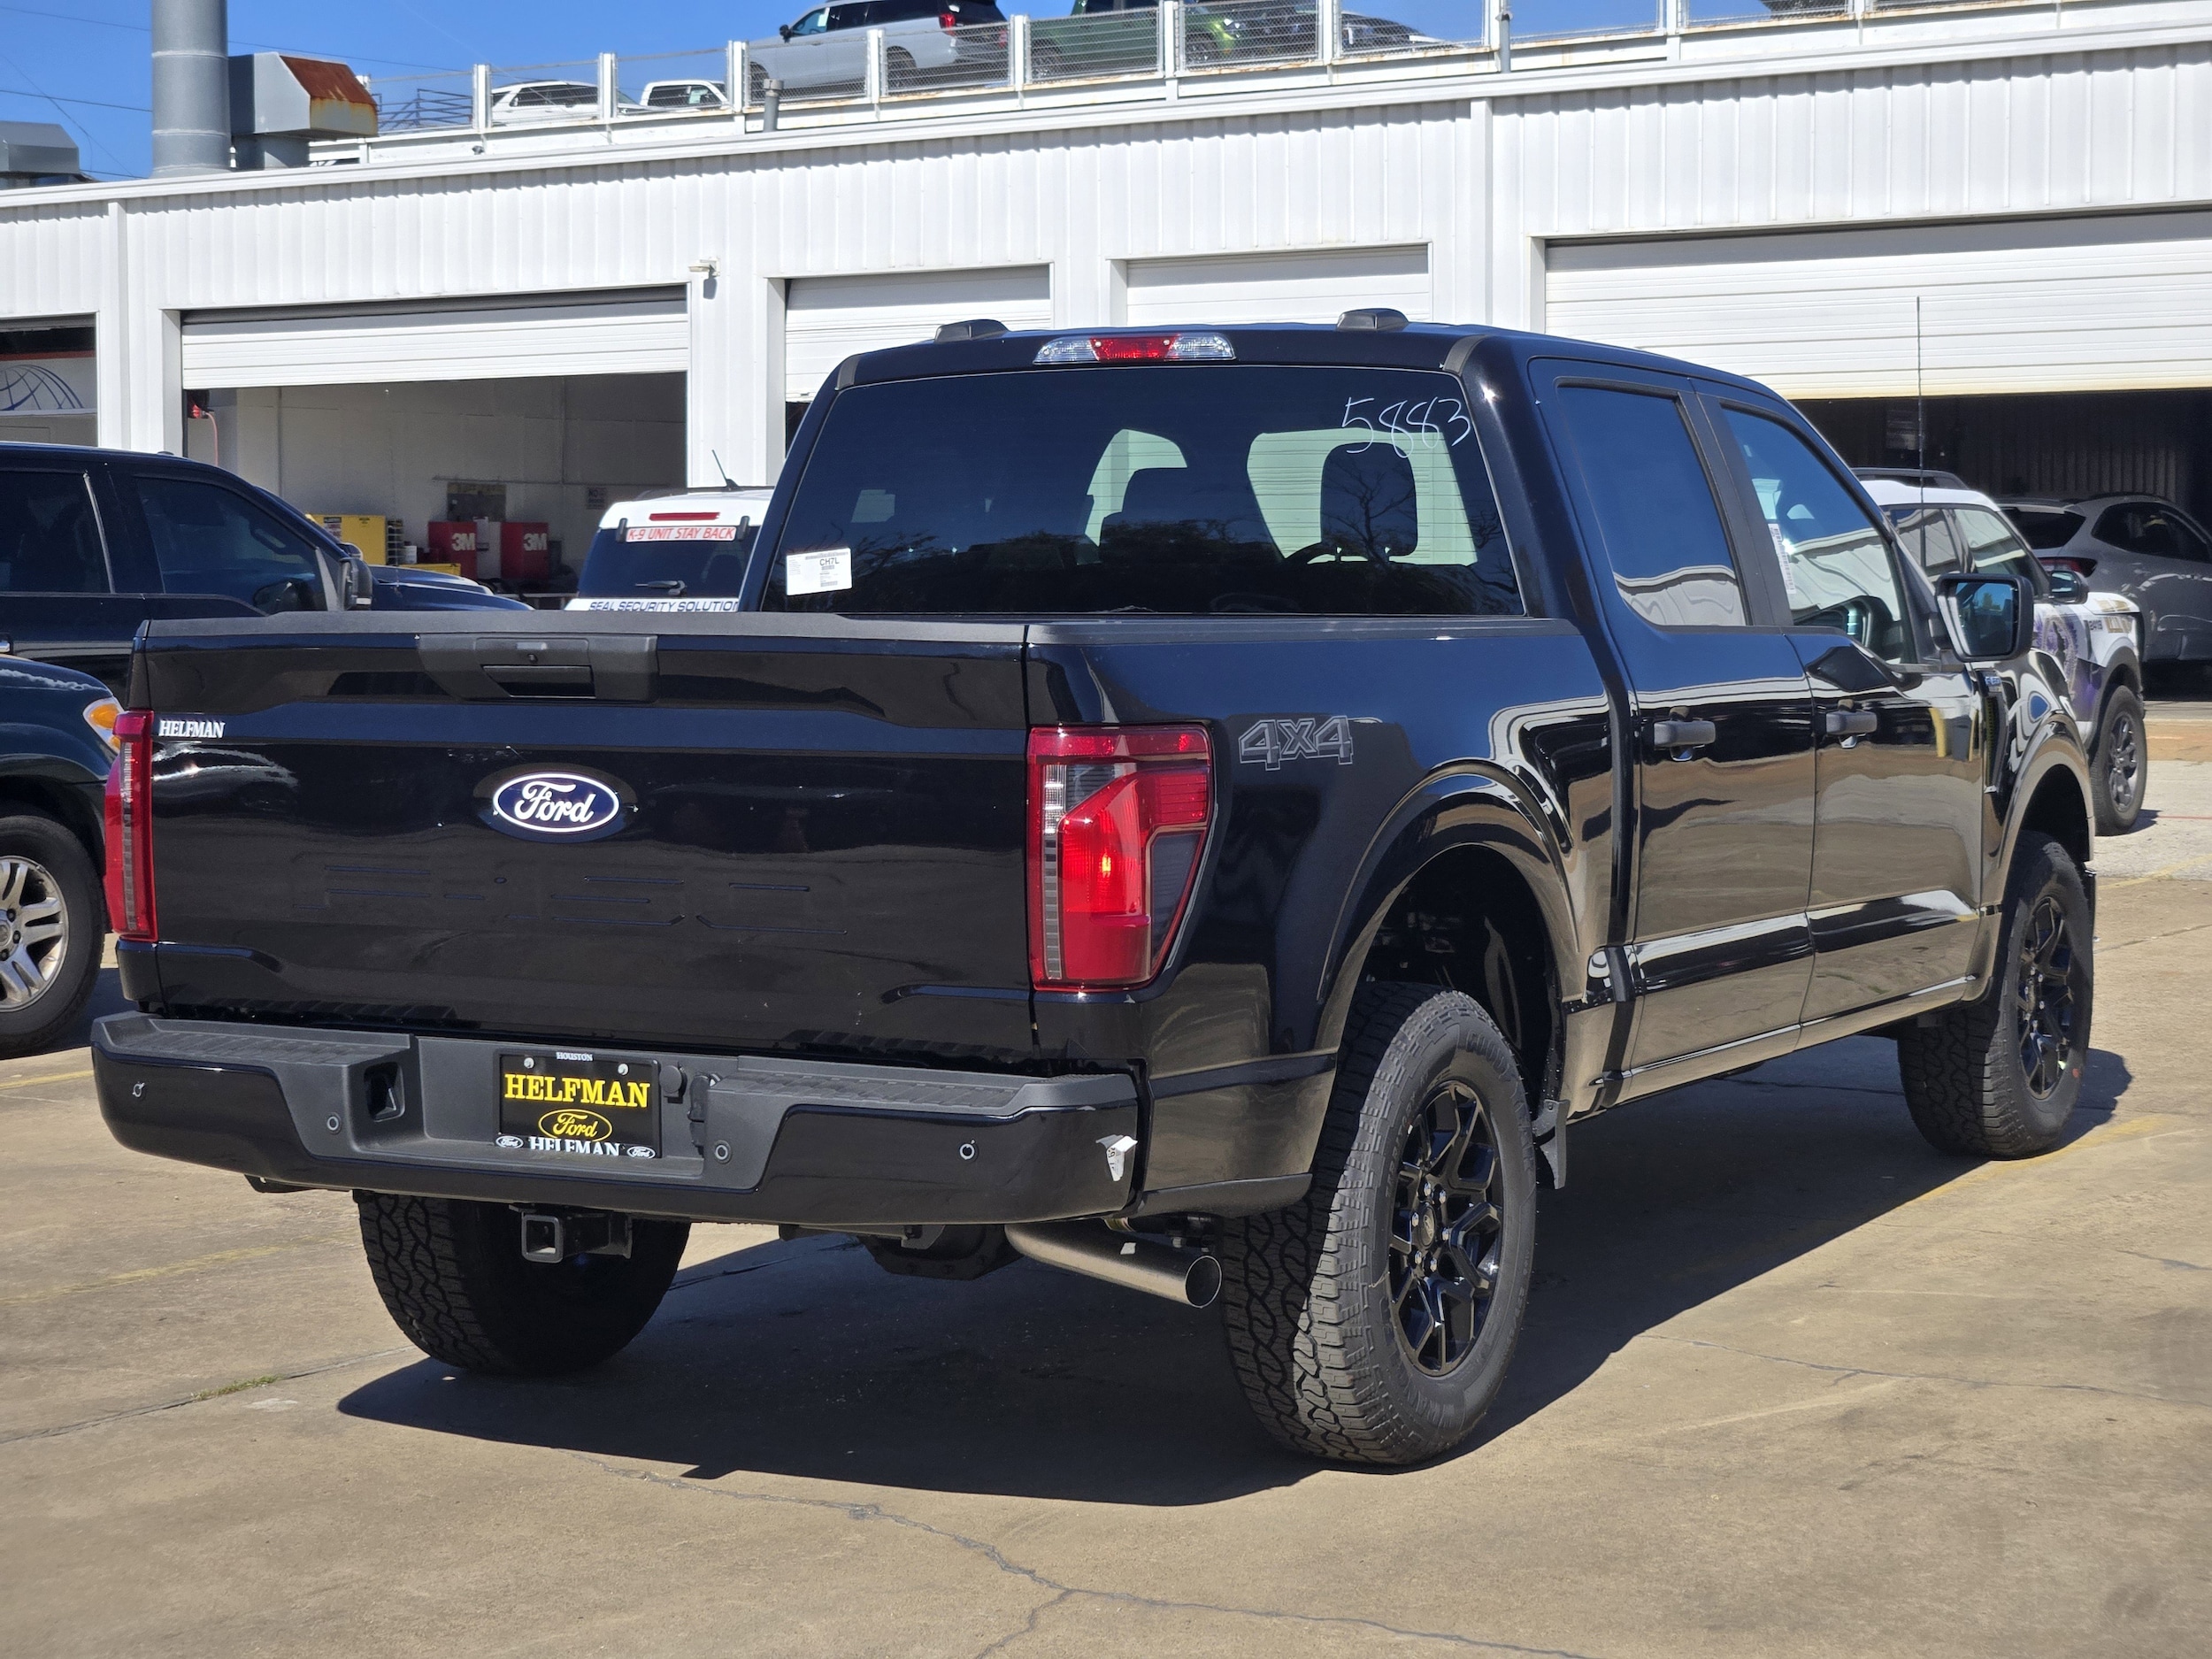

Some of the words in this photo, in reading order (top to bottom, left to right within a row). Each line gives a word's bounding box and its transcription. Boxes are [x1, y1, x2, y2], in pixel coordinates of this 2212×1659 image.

[452, 533, 476, 550] 3M
[524, 533, 548, 550] 3M
[628, 528, 644, 540] K-9
[649, 528, 672, 540] UNIT
[674, 527, 700, 539] STAY
[703, 527, 733, 539] BACK
[618, 602, 675, 611] SECURITY
[158, 719, 226, 738] HELFMAN
[514, 780, 596, 823] Ford
[556, 1051, 593, 1062] HOUSTON
[504, 1073, 651, 1108] HELFMAN
[552, 1112, 599, 1138] Ford
